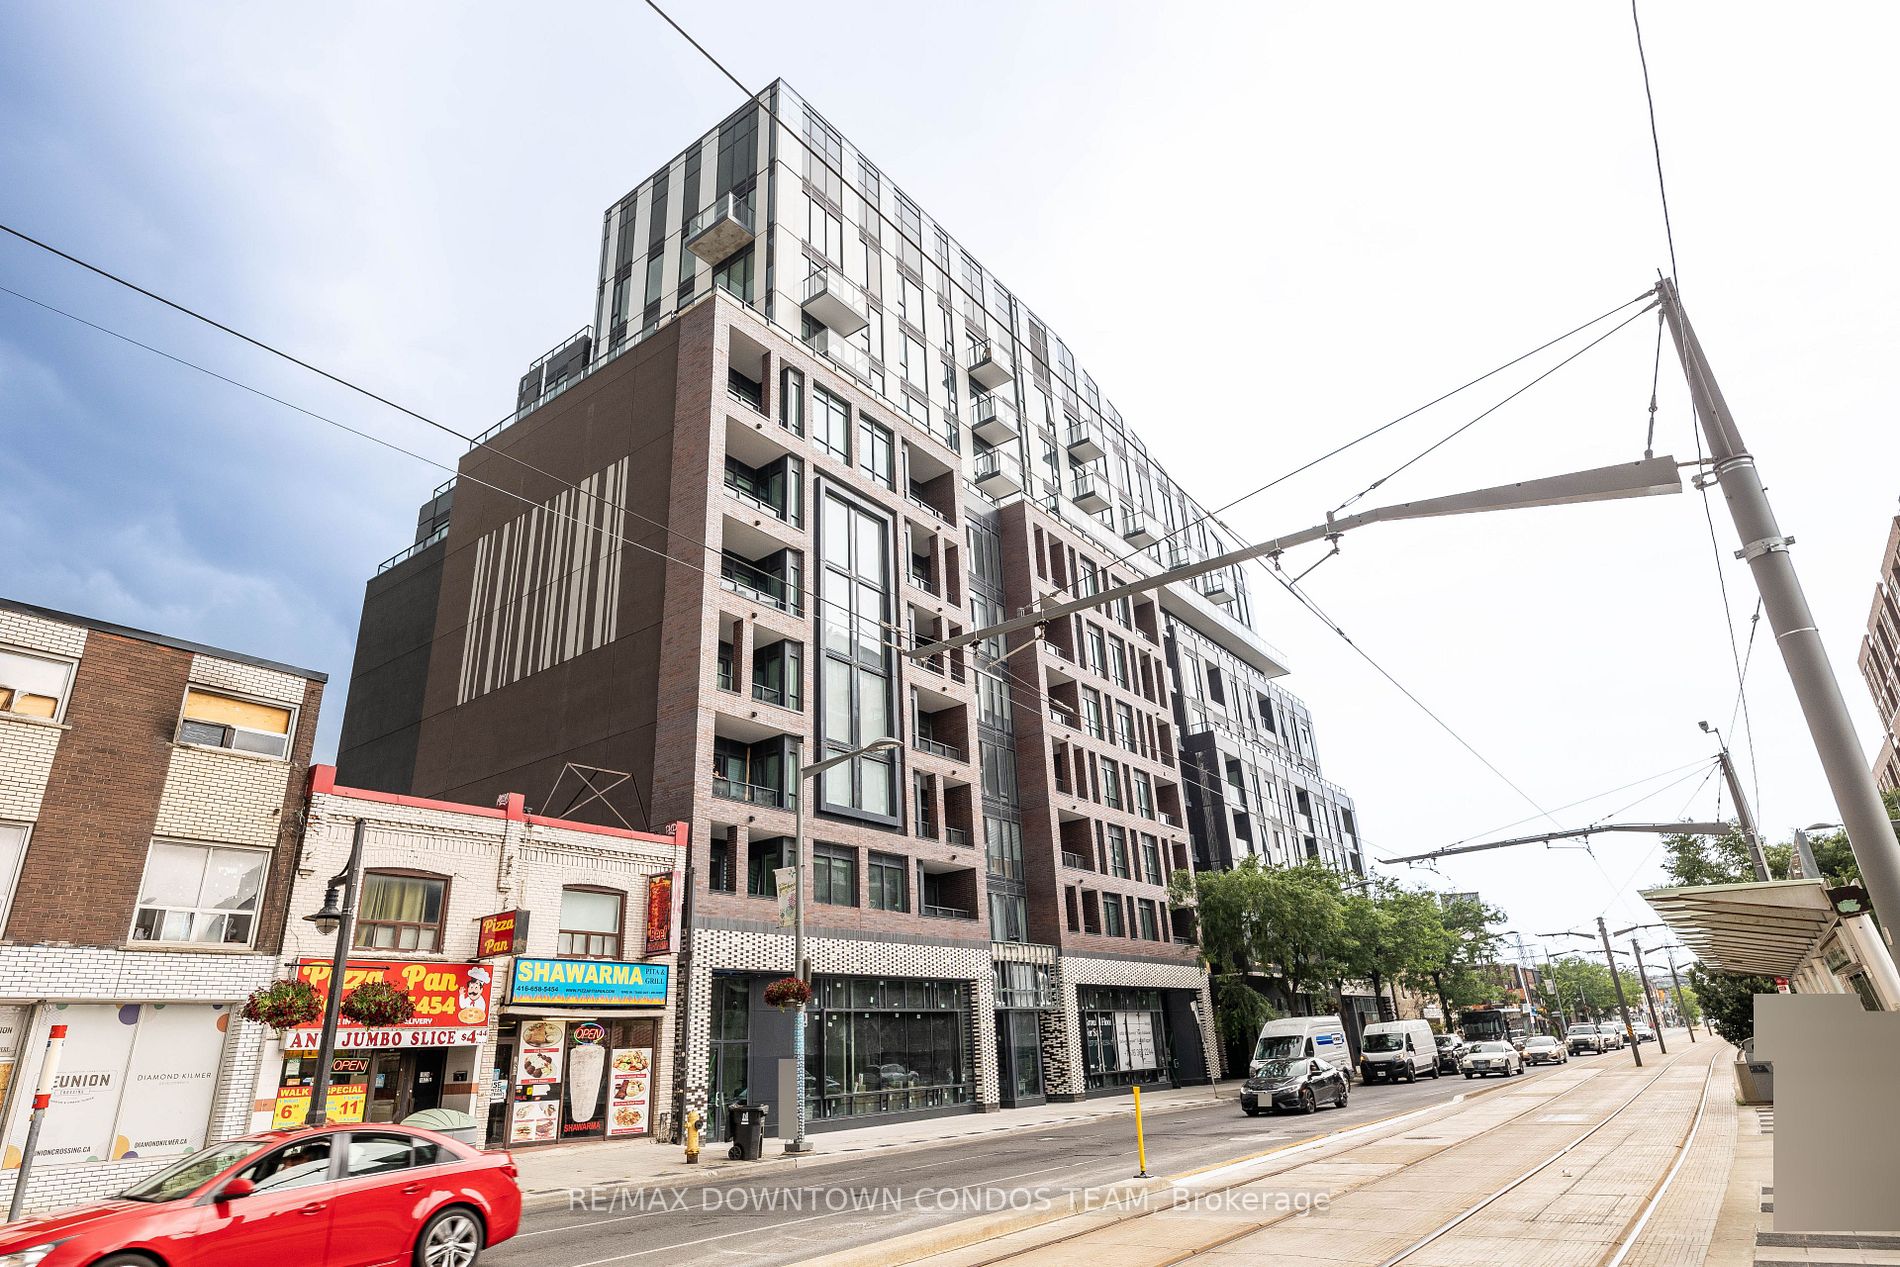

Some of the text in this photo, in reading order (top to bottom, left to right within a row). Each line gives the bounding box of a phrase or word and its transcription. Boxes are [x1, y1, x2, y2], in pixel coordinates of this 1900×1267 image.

[483, 918, 514, 934] Pizza
[485, 938, 509, 953] Pan
[402, 964, 458, 992] Pan
[518, 961, 643, 985] SHAWARMA
[645, 977, 665, 985] GRILL
[290, 1031, 319, 1047] AN
[341, 1031, 402, 1047] JUMBO
[410, 1029, 456, 1046] SLICE
[575, 1028, 601, 1040] OPEN
[333, 1060, 367, 1071] OPEN
[137, 1073, 179, 1081] DIAMOND
[281, 1088, 309, 1097] WALK
[564, 1121, 601, 1132] SHAWARMA
